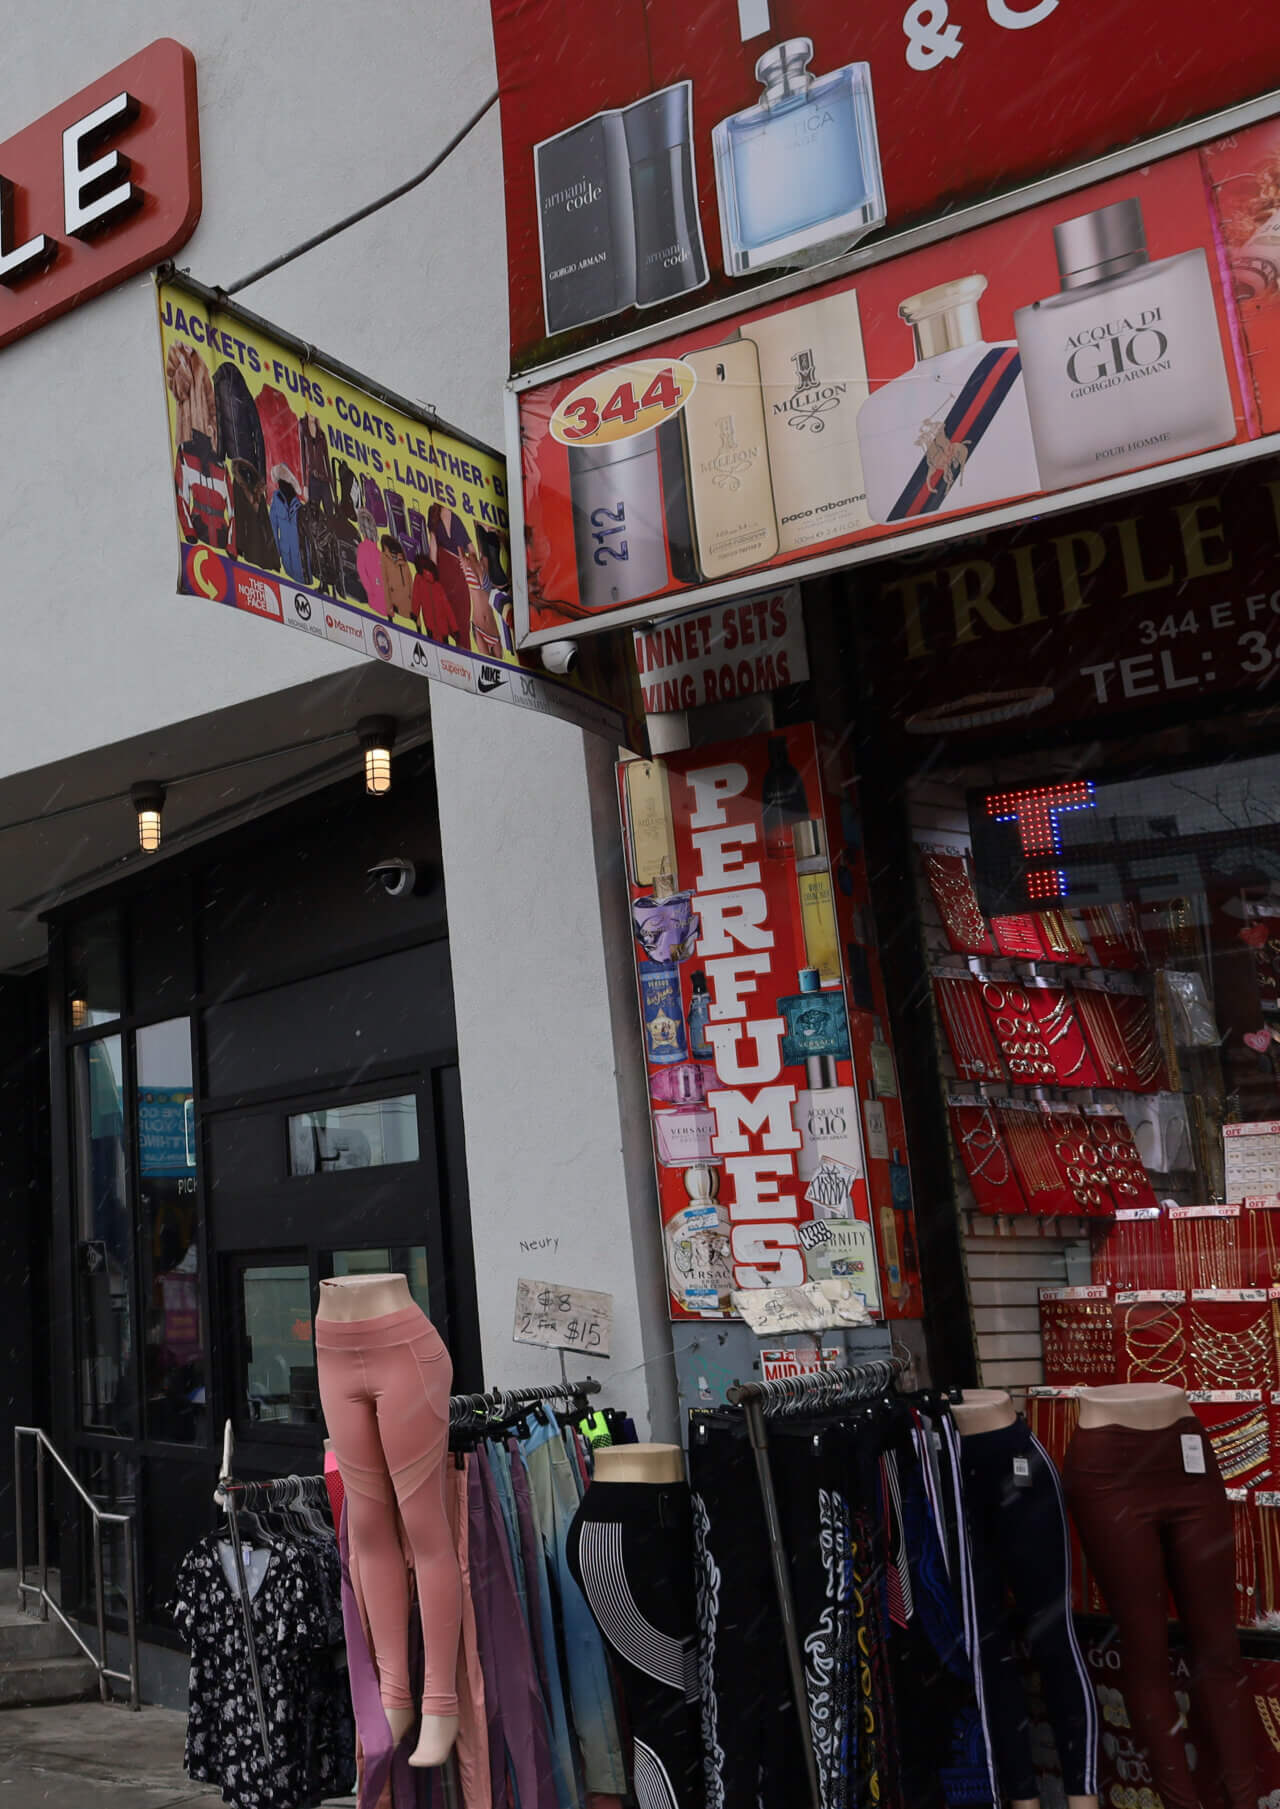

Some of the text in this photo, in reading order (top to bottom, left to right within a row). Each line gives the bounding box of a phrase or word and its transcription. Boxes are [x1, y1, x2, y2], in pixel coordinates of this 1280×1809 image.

[545, 176, 587, 209] armani
[566, 183, 602, 212] code
[549, 252, 607, 280] GIORGIO ARMANI
[1065, 307, 1162, 351] ACQUA DI
[161, 301, 261, 373] JACKETS
[273, 359, 325, 407] FURS
[336, 396, 396, 445] COATS
[405, 432, 485, 488] LEATHER
[1071, 360, 1171, 400] GIORGIO ARMANI
[562, 367, 682, 440] 344
[773, 384, 848, 415] MILLION
[1095, 432, 1171, 461] POUR HOMME
[327, 424, 383, 473] MEN'S
[394, 459, 457, 508] LADIES
[462, 492, 475, 516] &
[781, 510, 813, 526] paco
[815, 493, 867, 515] rabanne
[591, 502, 629, 566] 212
[238, 584, 266, 601] NORTH
[249, 577, 266, 590] THE
[880, 496, 1234, 662] TRIPLE
[247, 597, 267, 611] FACE
[722, 596, 787, 649] SETS
[1137, 603, 1200, 645] 344
[1210, 601, 1236, 630] E
[334, 619, 363, 638] Marmot
[482, 664, 501, 683] NIKE
[703, 650, 792, 705] ROOMS
[1080, 645, 1217, 705] TEL:
[686, 762, 810, 1290] PERFUMES
[521, 1313, 533, 1335] 2
[563, 1318, 601, 1349] $15
